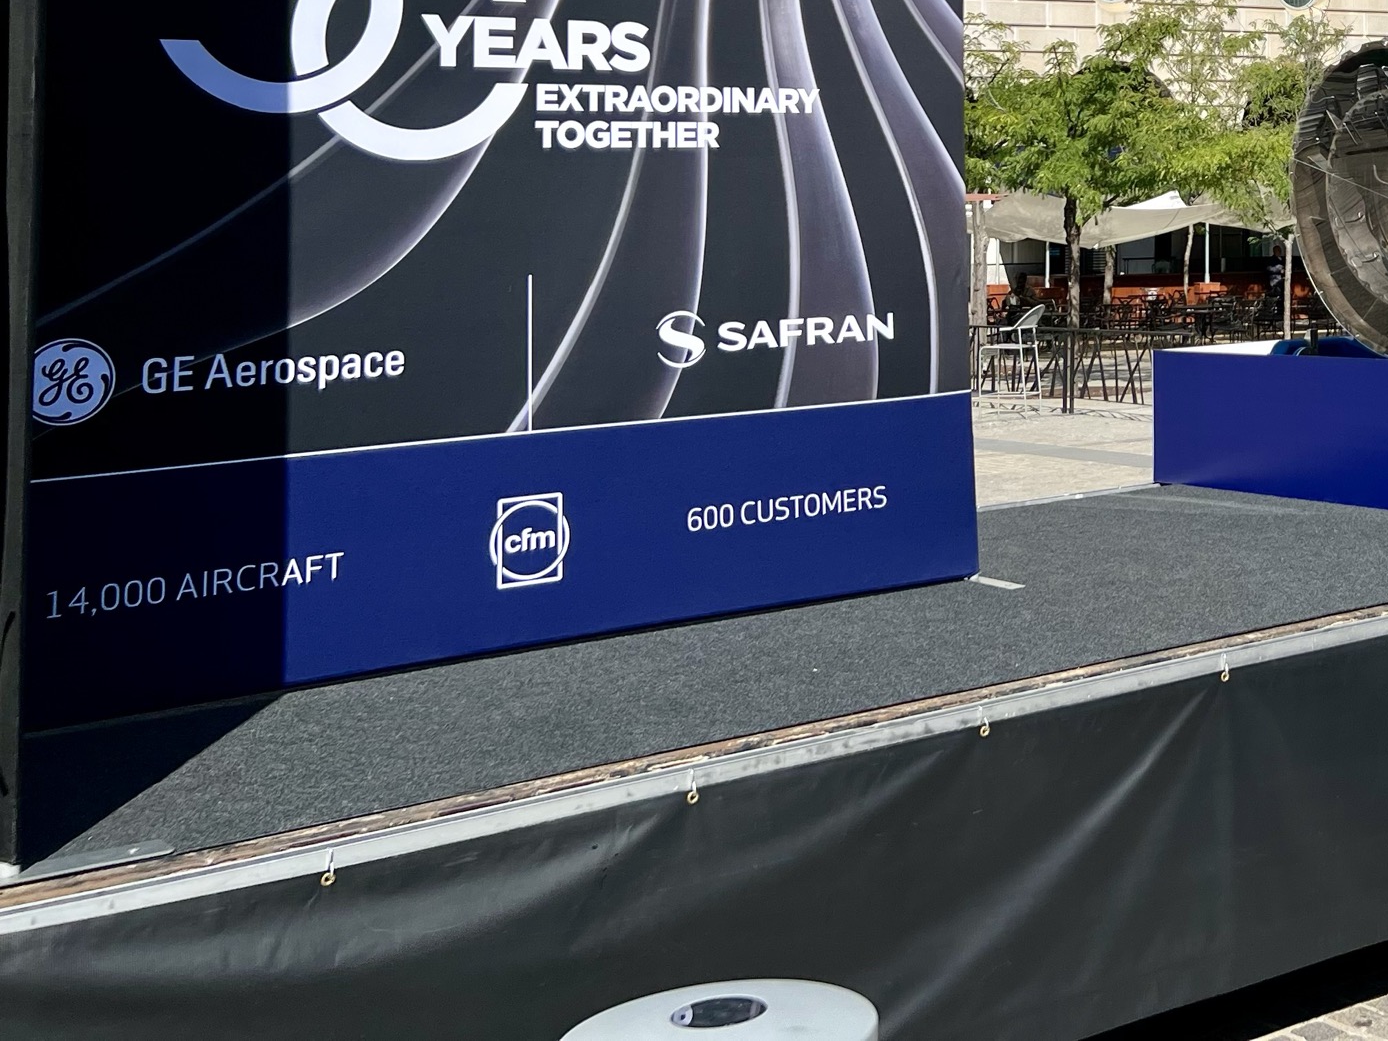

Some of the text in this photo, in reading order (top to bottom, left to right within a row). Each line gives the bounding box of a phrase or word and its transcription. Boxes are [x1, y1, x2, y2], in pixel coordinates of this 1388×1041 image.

[421, 13, 651, 73] YEARS
[535, 84, 820, 115] EXTRAORDINARY
[535, 120, 721, 150] TOGETHER
[717, 312, 895, 352] SAFRAN
[141, 355, 196, 394] GE
[204, 348, 406, 391] Aerospace
[687, 485, 888, 532] 600 CUSTOMERS
[503, 526, 557, 556] cfm
[46, 551, 345, 620] 14,000 AIRCRAFT
